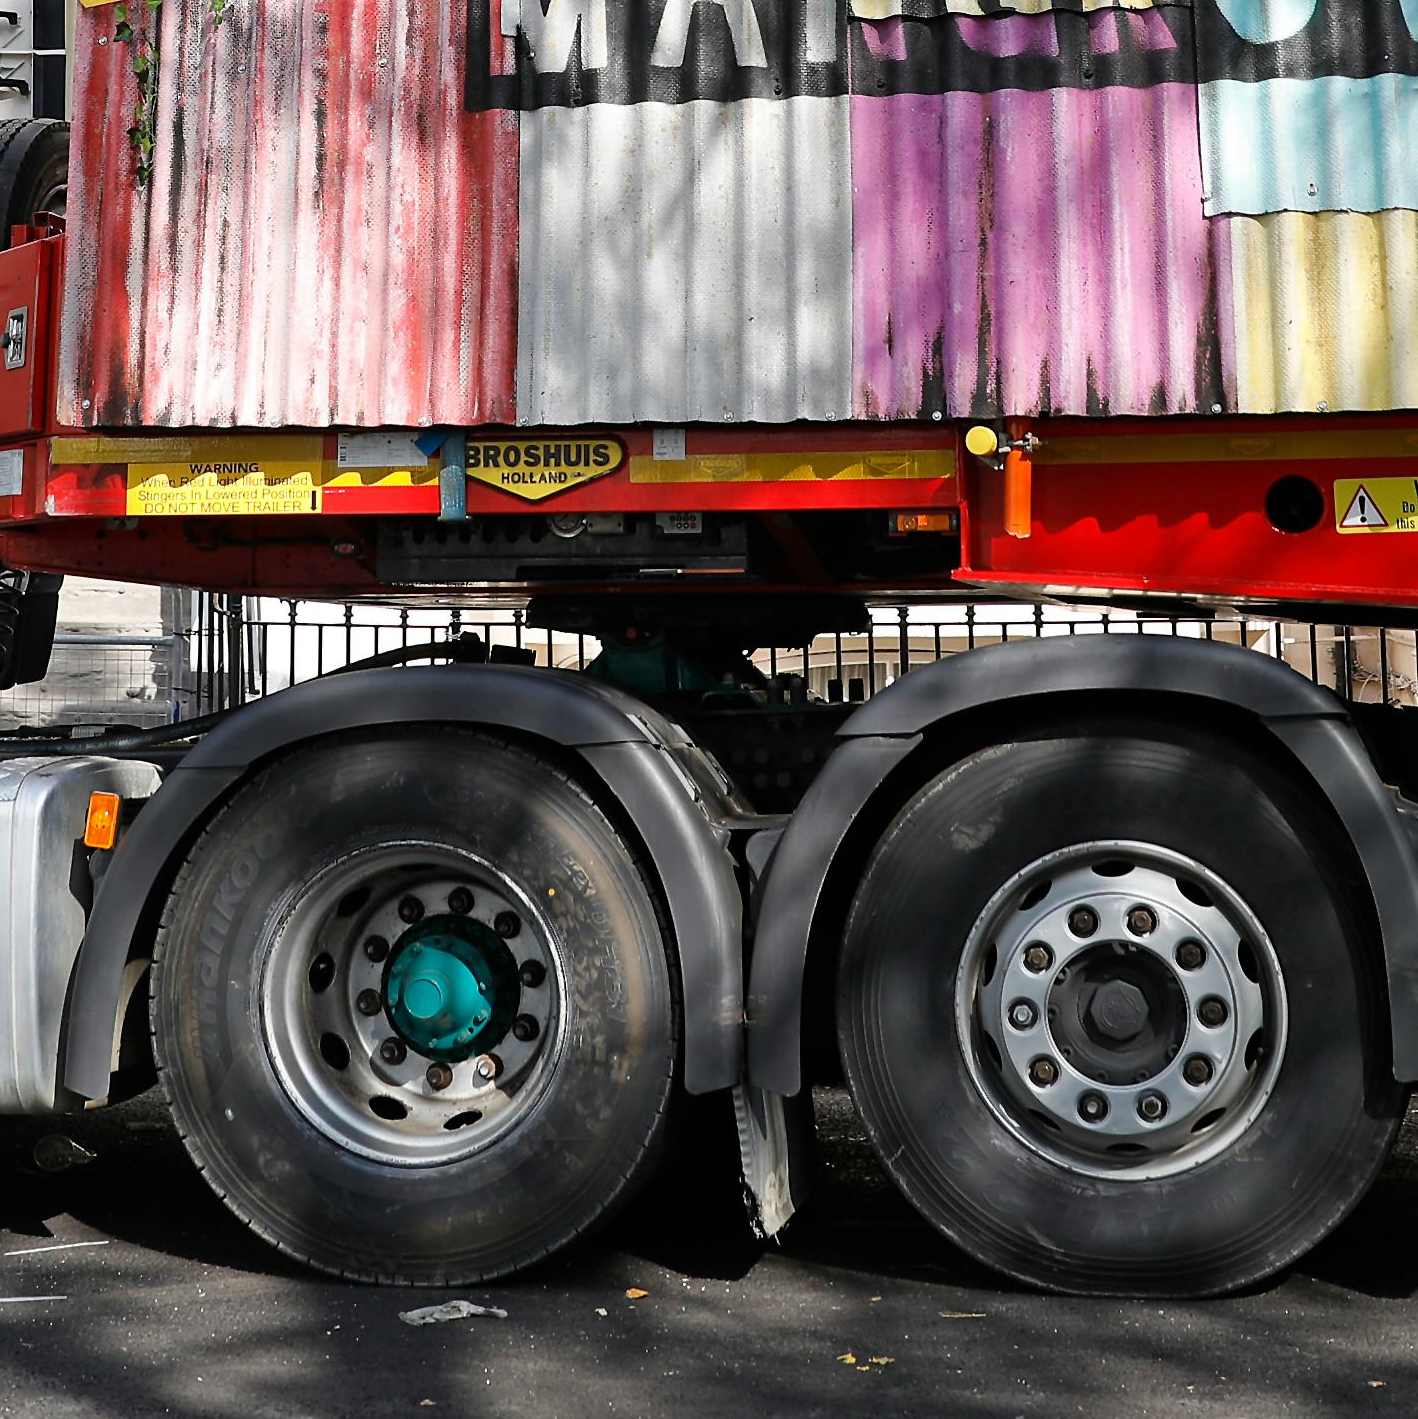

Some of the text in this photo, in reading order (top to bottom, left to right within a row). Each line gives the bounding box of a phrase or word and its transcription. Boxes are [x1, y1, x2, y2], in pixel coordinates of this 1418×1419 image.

[466, 444, 610, 468] BROSHUIS
[190, 463, 259, 474] WARNING
[141, 476, 308, 489] When Red Light Illuminated
[501, 471, 568, 484] HOLLAND
[138, 489, 311, 503] Stingers In Lowered Position
[144, 501, 302, 514] DO NOT MOVE TRAILER
[1402, 501, 1415, 513] Do
[1396, 518, 1416, 529] this
